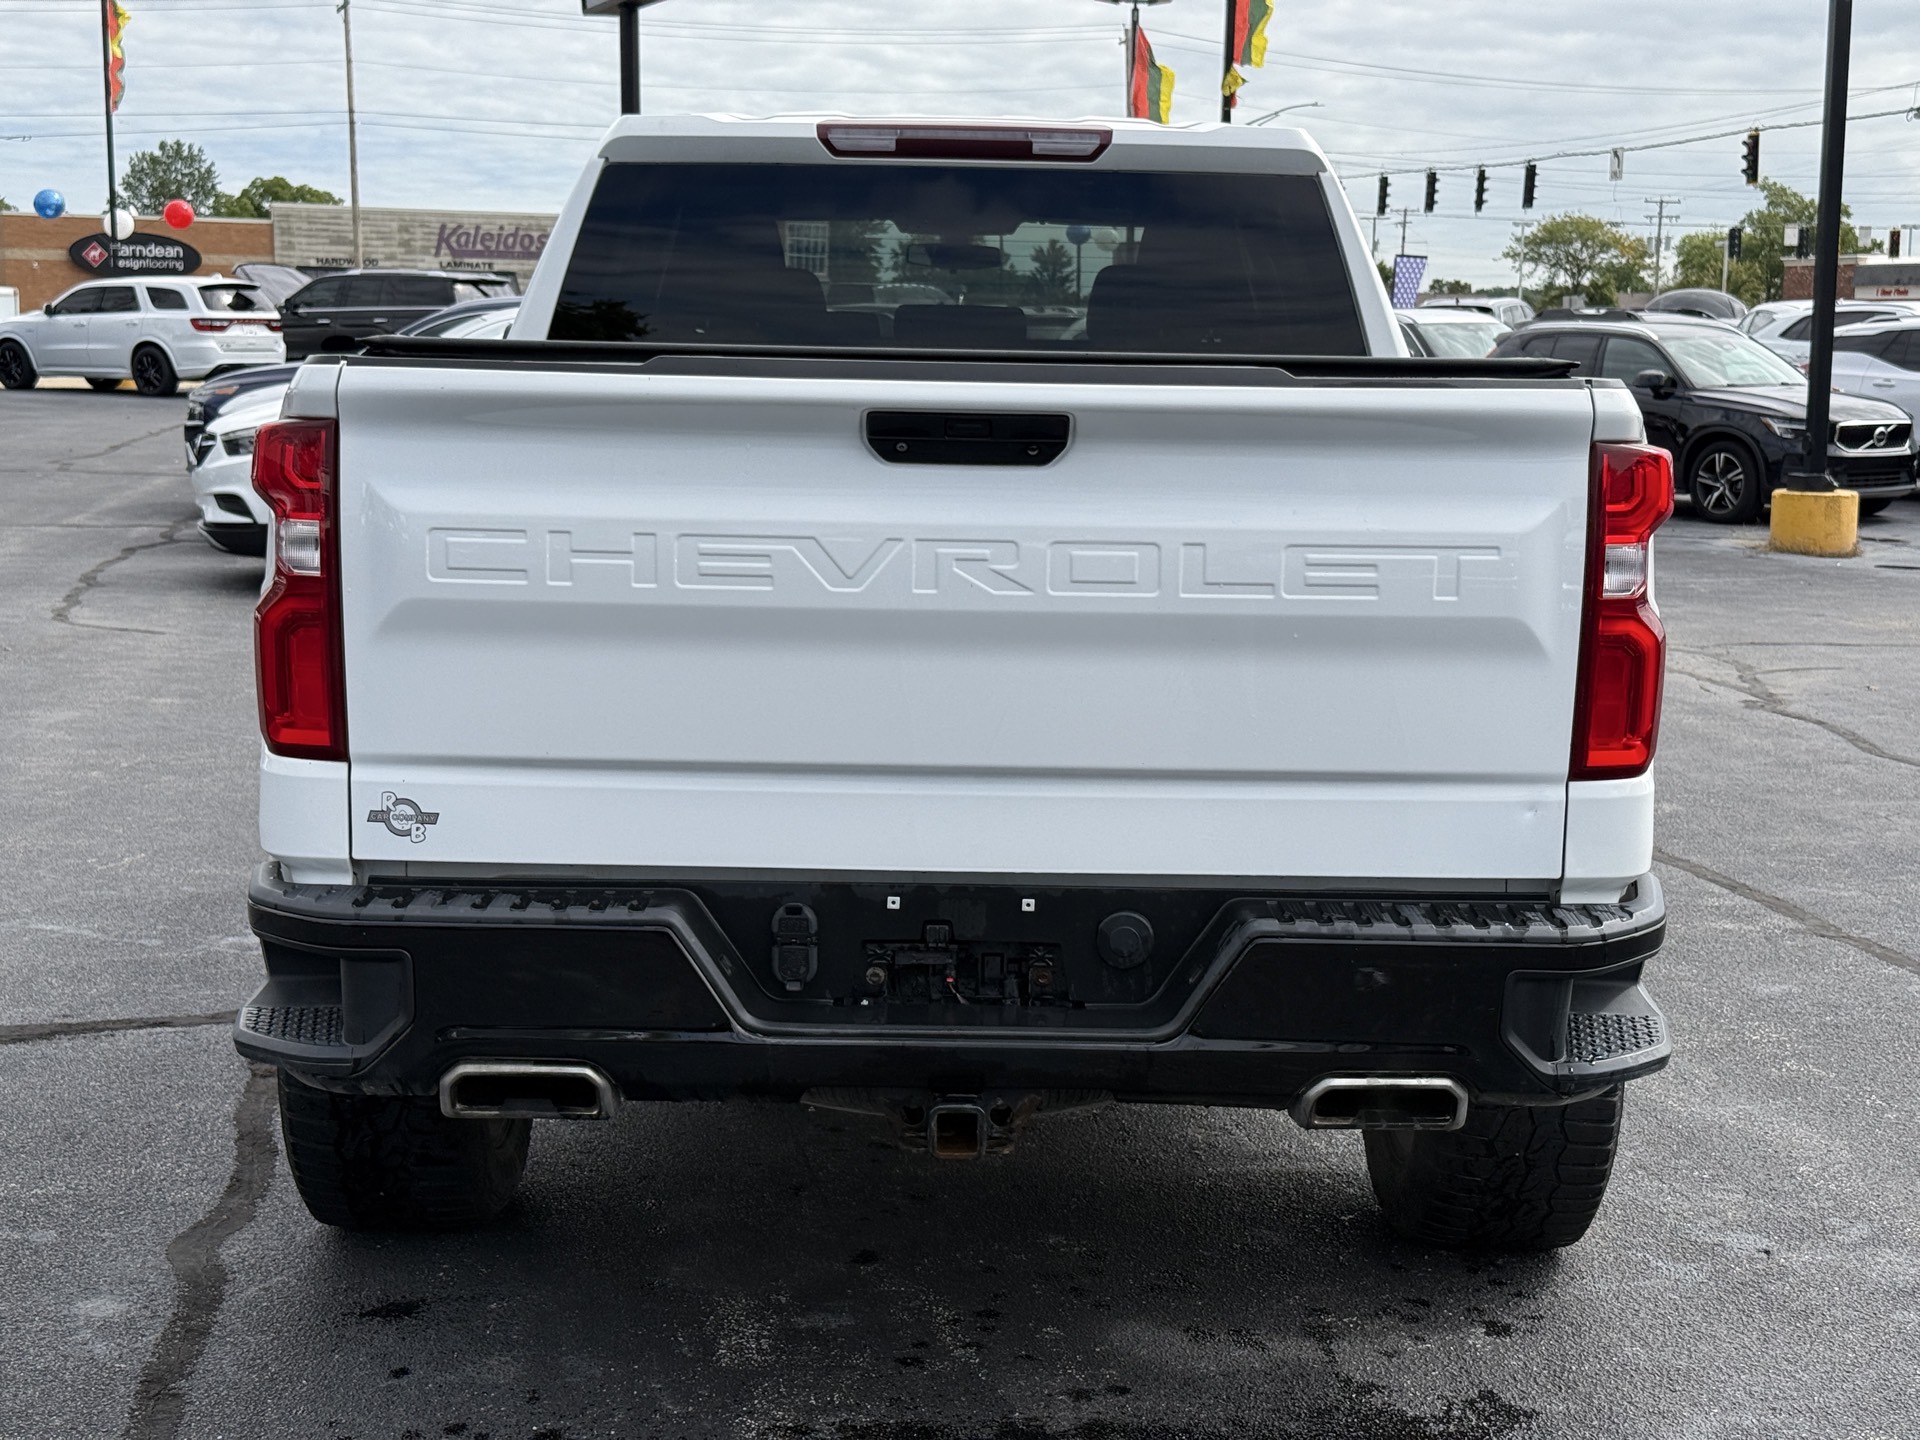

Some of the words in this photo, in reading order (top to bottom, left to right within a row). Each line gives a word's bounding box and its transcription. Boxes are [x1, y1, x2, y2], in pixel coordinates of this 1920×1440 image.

[110, 243, 184, 258] arndean
[110, 258, 184, 271] esignflooring
[316, 257, 379, 267] HARDWOD
[440, 261, 495, 270] LAMINATE
[427, 527, 1501, 600] CHEVROLET
